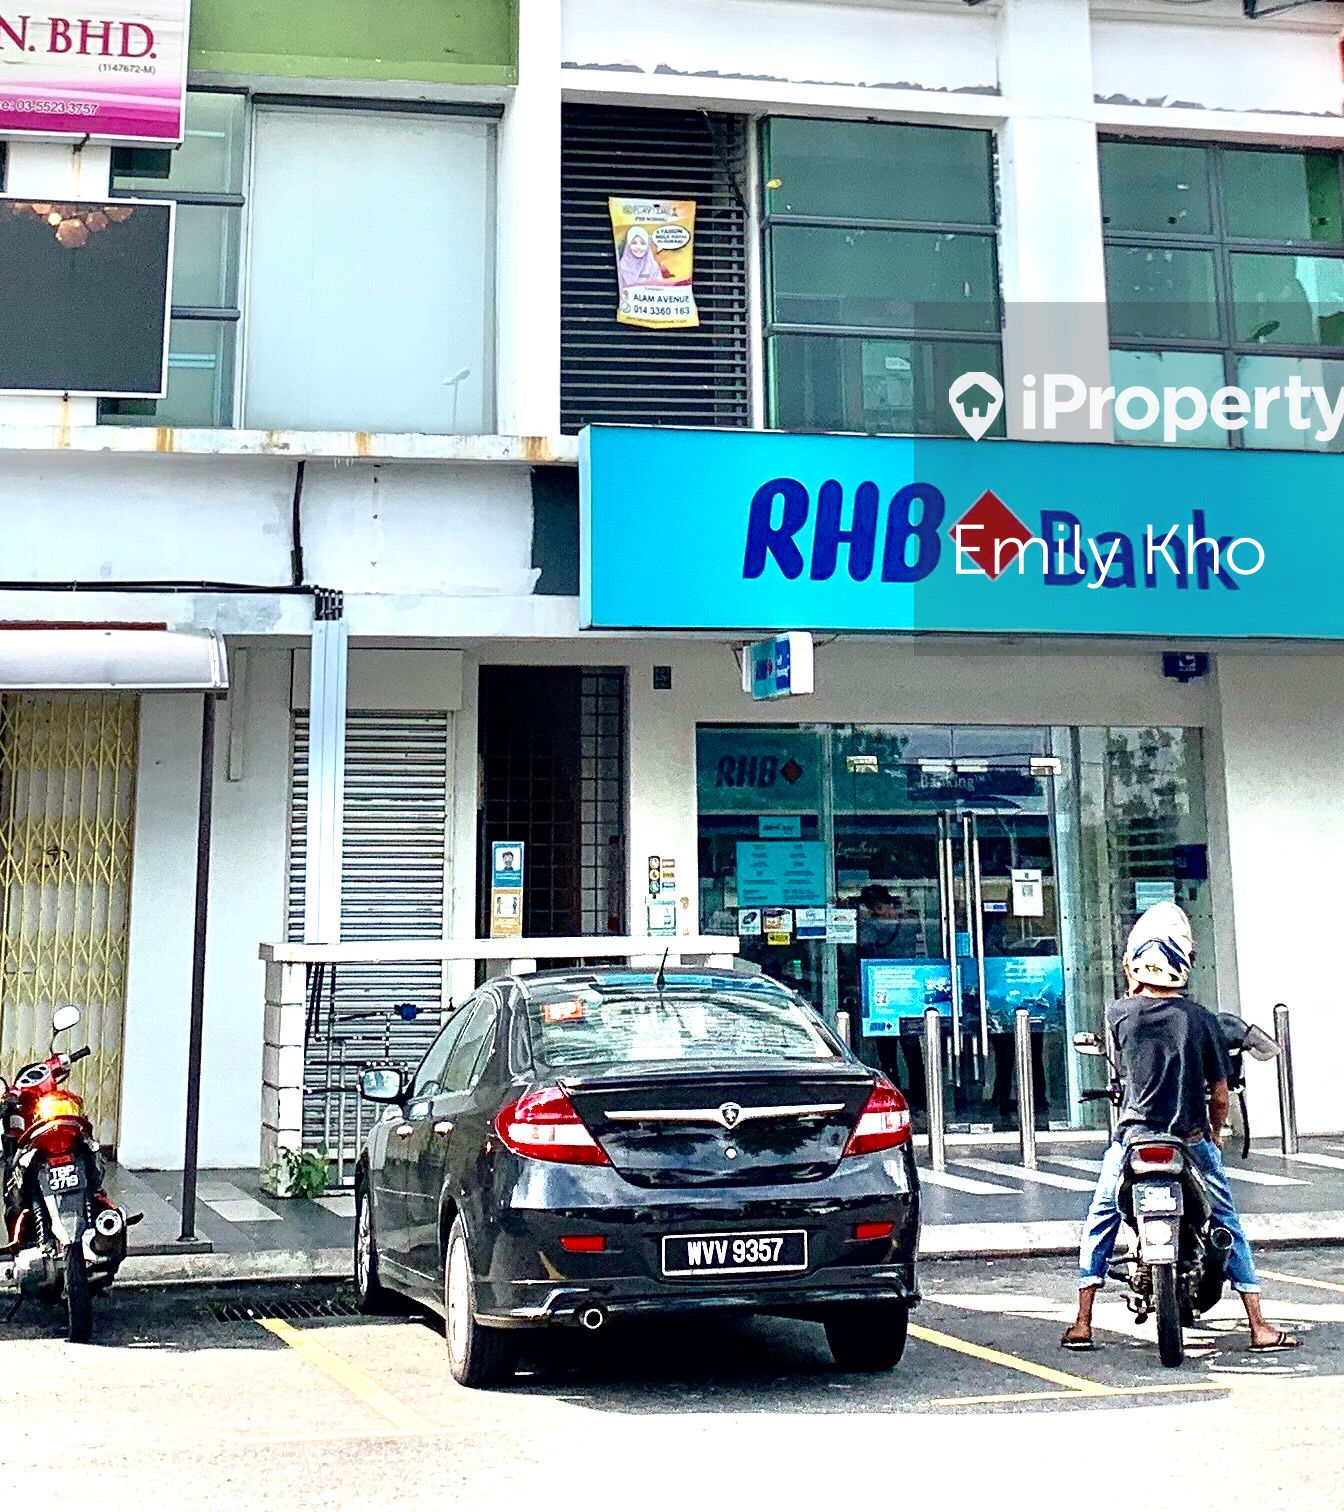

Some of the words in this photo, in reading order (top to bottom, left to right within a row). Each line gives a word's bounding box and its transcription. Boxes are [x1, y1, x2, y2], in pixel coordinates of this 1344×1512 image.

[47, 17, 158, 59] BHD.
[66, 101, 99, 116] 3757
[657, 295, 690, 304] AVENUE
[742, 478, 946, 583] RHB
[1040, 509, 1240, 590] Bank
[716, 755, 778, 788] RHB
[686, 1239, 727, 1267] WVV
[731, 1237, 783, 1263] 9357
